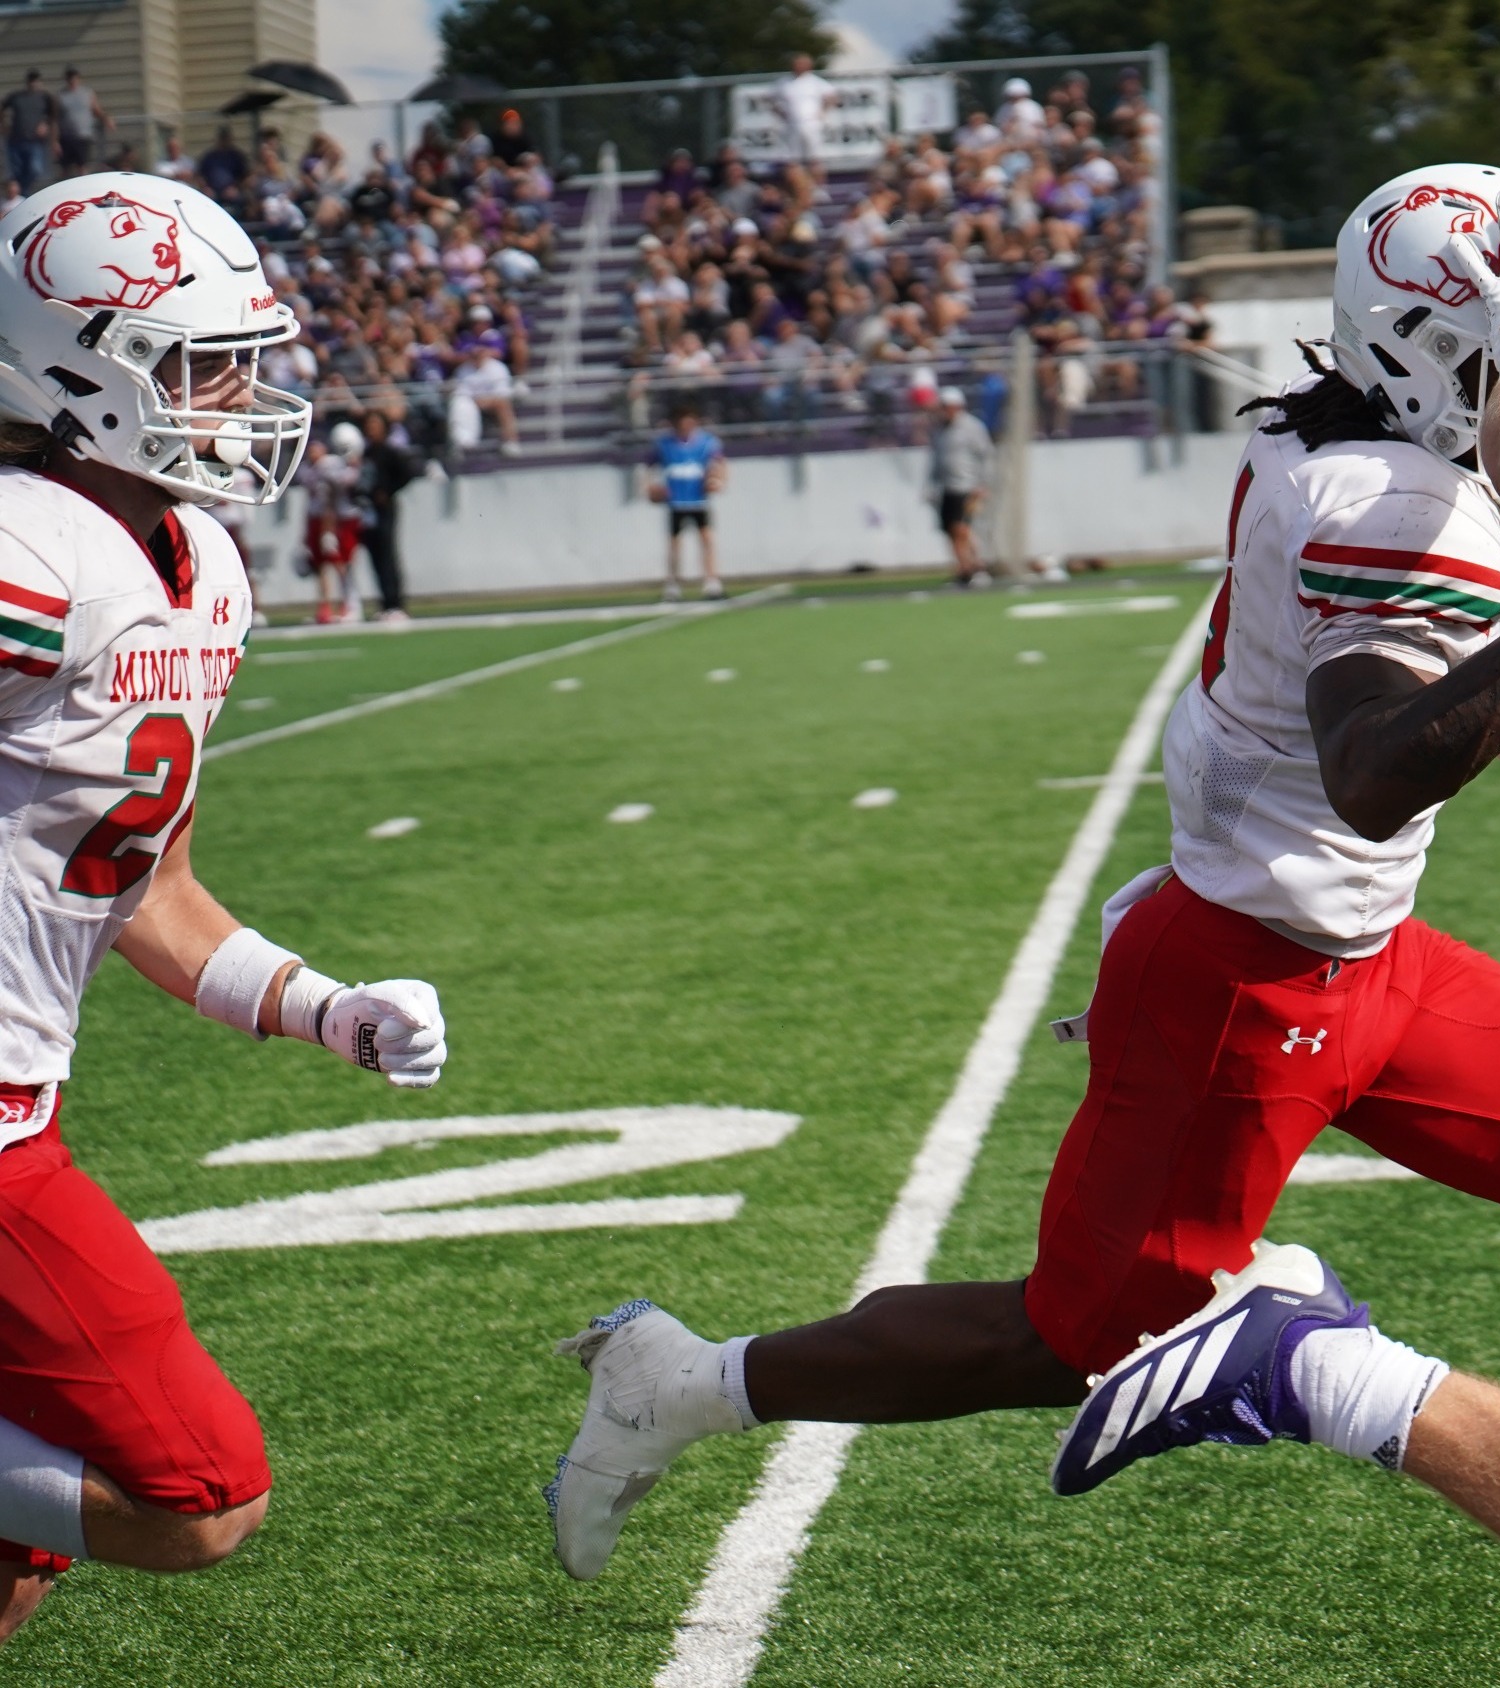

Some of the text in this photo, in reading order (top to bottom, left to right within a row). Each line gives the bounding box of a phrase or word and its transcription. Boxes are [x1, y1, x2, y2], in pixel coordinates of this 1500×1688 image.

[250, 293, 277, 312] Ridde
[109, 648, 192, 703] MINOT
[58, 709, 212, 899] 2
[351, 1015, 360, 1066] SUPERST
